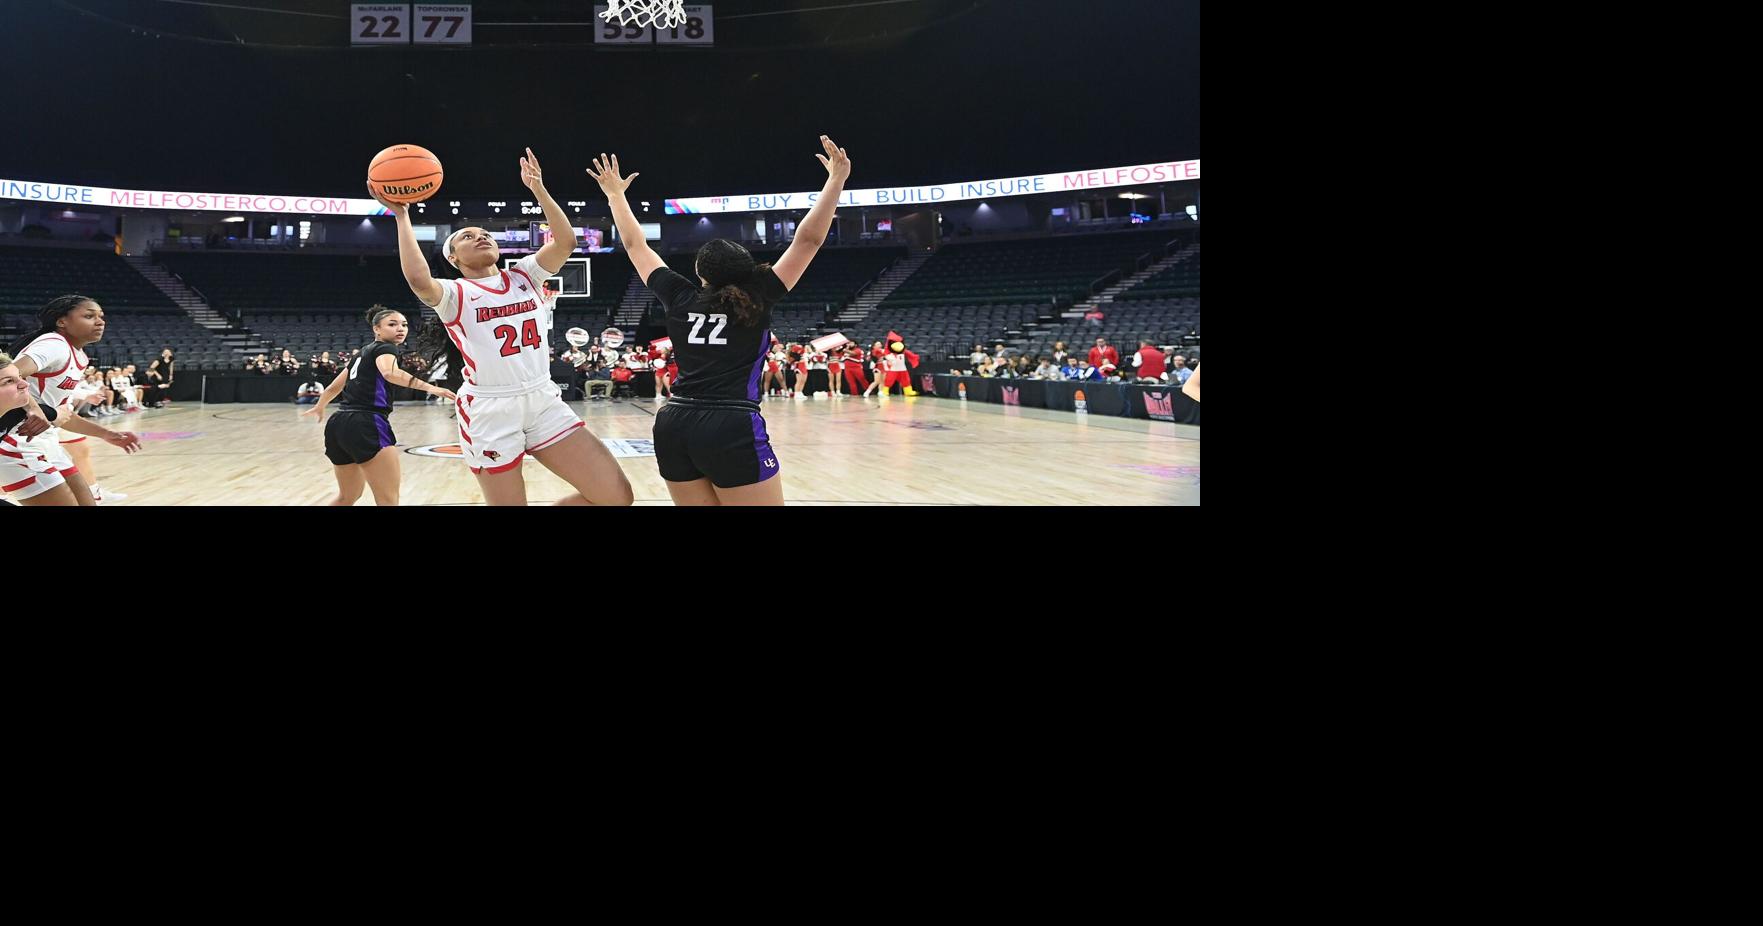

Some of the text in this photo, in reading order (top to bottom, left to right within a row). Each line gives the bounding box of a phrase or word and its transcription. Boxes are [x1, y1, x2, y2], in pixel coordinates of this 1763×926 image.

[360, 15, 401, 38] 22
[422, 16, 464, 38] 77
[1, 181, 348, 213] INSURE MELFOSTERCO.COM
[383, 181, 434, 195] Wilson
[748, 162, 1199, 209] BUY SL BUILD INSURE MELFOSTE
[494, 318, 541, 357] 24
[687, 312, 728, 345] 22
